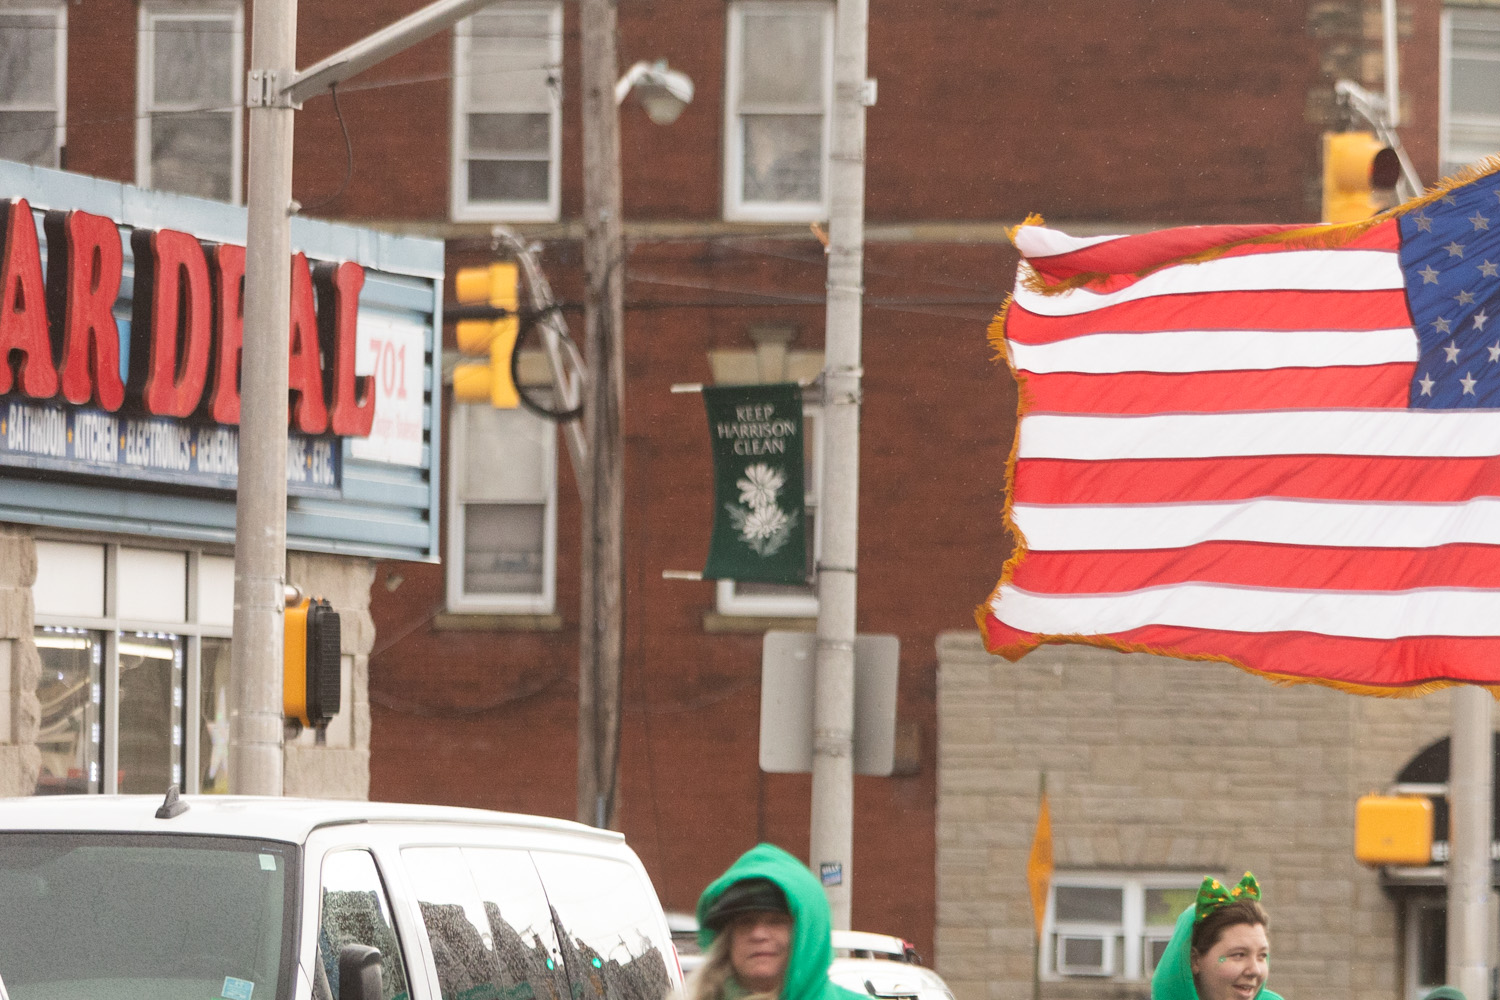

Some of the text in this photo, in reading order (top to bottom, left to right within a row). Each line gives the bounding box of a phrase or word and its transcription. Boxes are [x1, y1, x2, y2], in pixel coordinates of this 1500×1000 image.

[370, 337, 407, 399] 701
[736, 404, 774, 422] KEEP
[8, 404, 66, 457] BATHROOM
[75, 414, 118, 463] KITCHEN
[126, 420, 190, 472] ELECTRONICS
[717, 421, 796, 439] HARRISON
[734, 438, 785, 455] CLEAN
